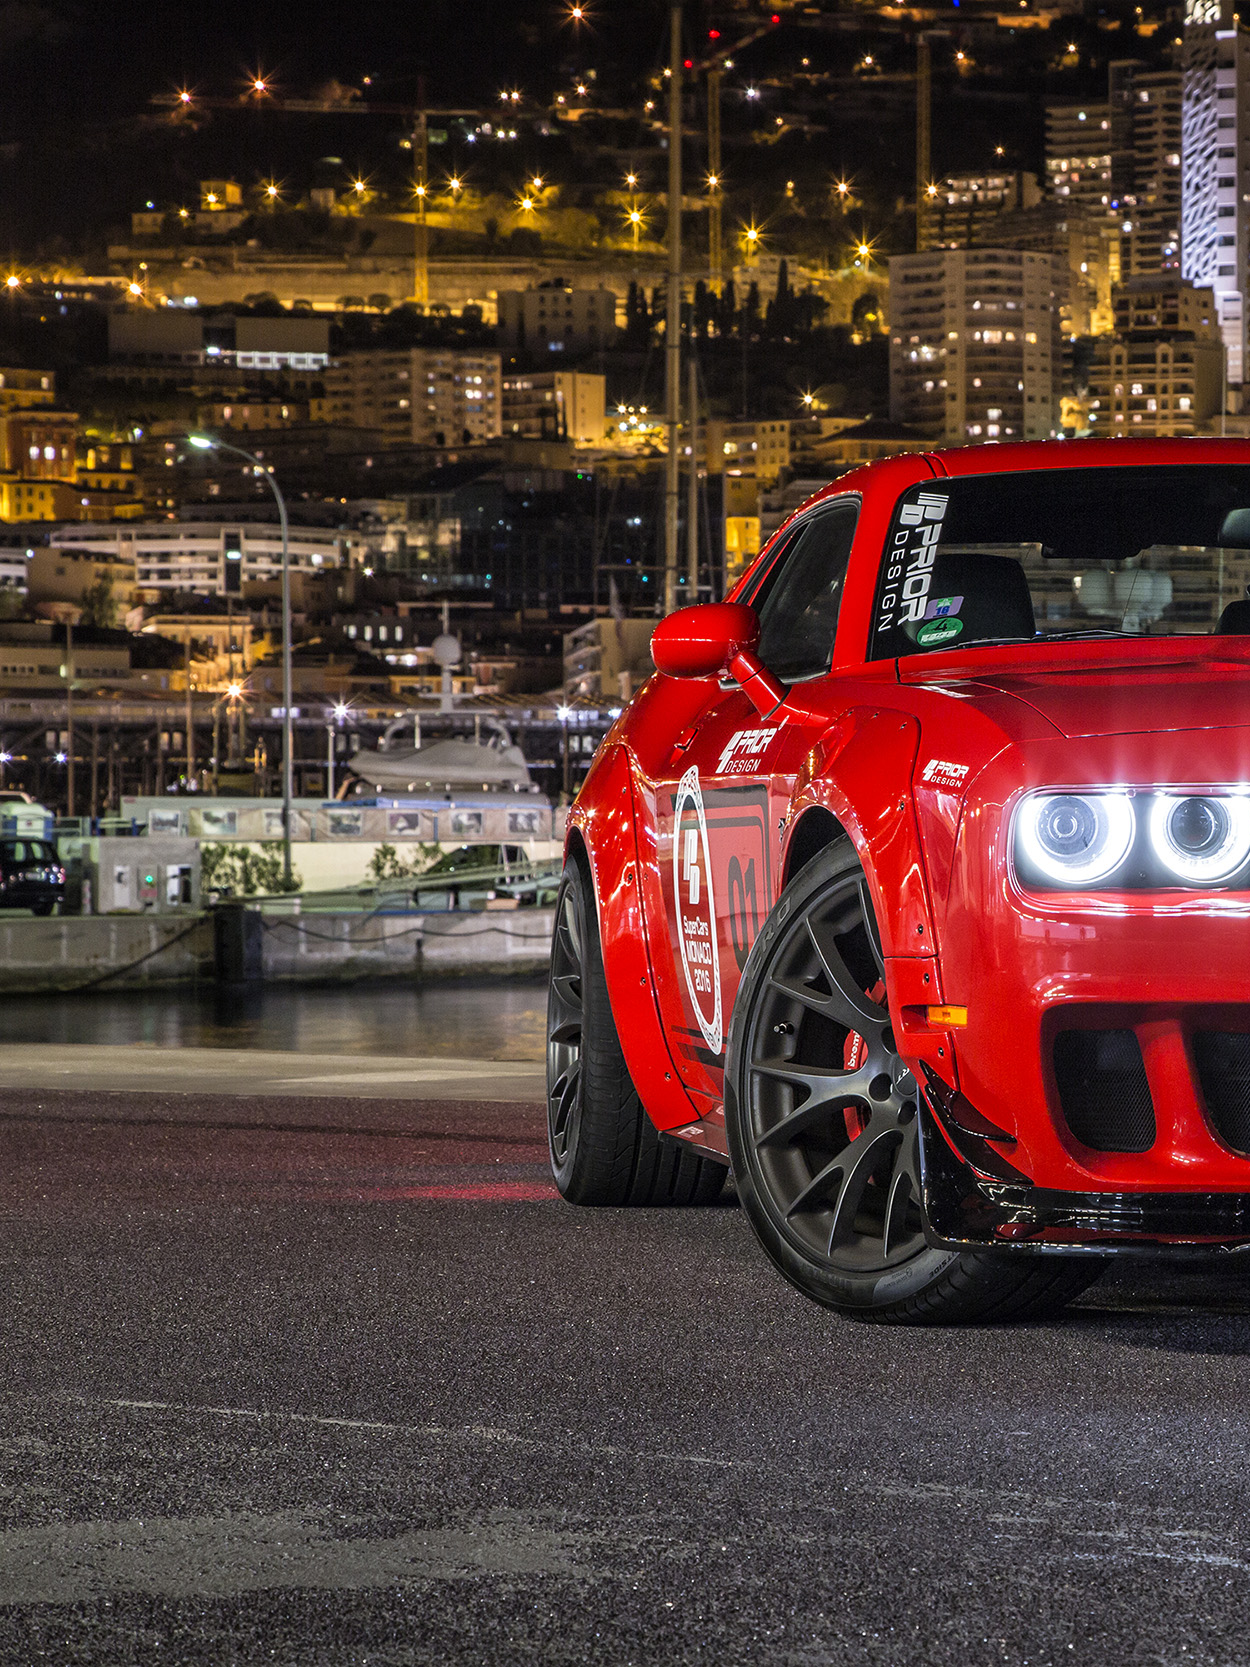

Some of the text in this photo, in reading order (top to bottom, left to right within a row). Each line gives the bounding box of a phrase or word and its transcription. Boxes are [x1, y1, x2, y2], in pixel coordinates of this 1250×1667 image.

[877, 530, 910, 632] DESIGN
[897, 523, 943, 626] PRIOR
[733, 728, 777, 755] PRIOR
[724, 759, 762, 773] DESIGN
[935, 761, 970, 779] PRIOR
[930, 775, 963, 788] DESIGN
[683, 915, 709, 939] SuperCars
[728, 856, 759, 974] 01
[686, 940, 712, 965] MONACO
[694, 968, 712, 993] 2016
